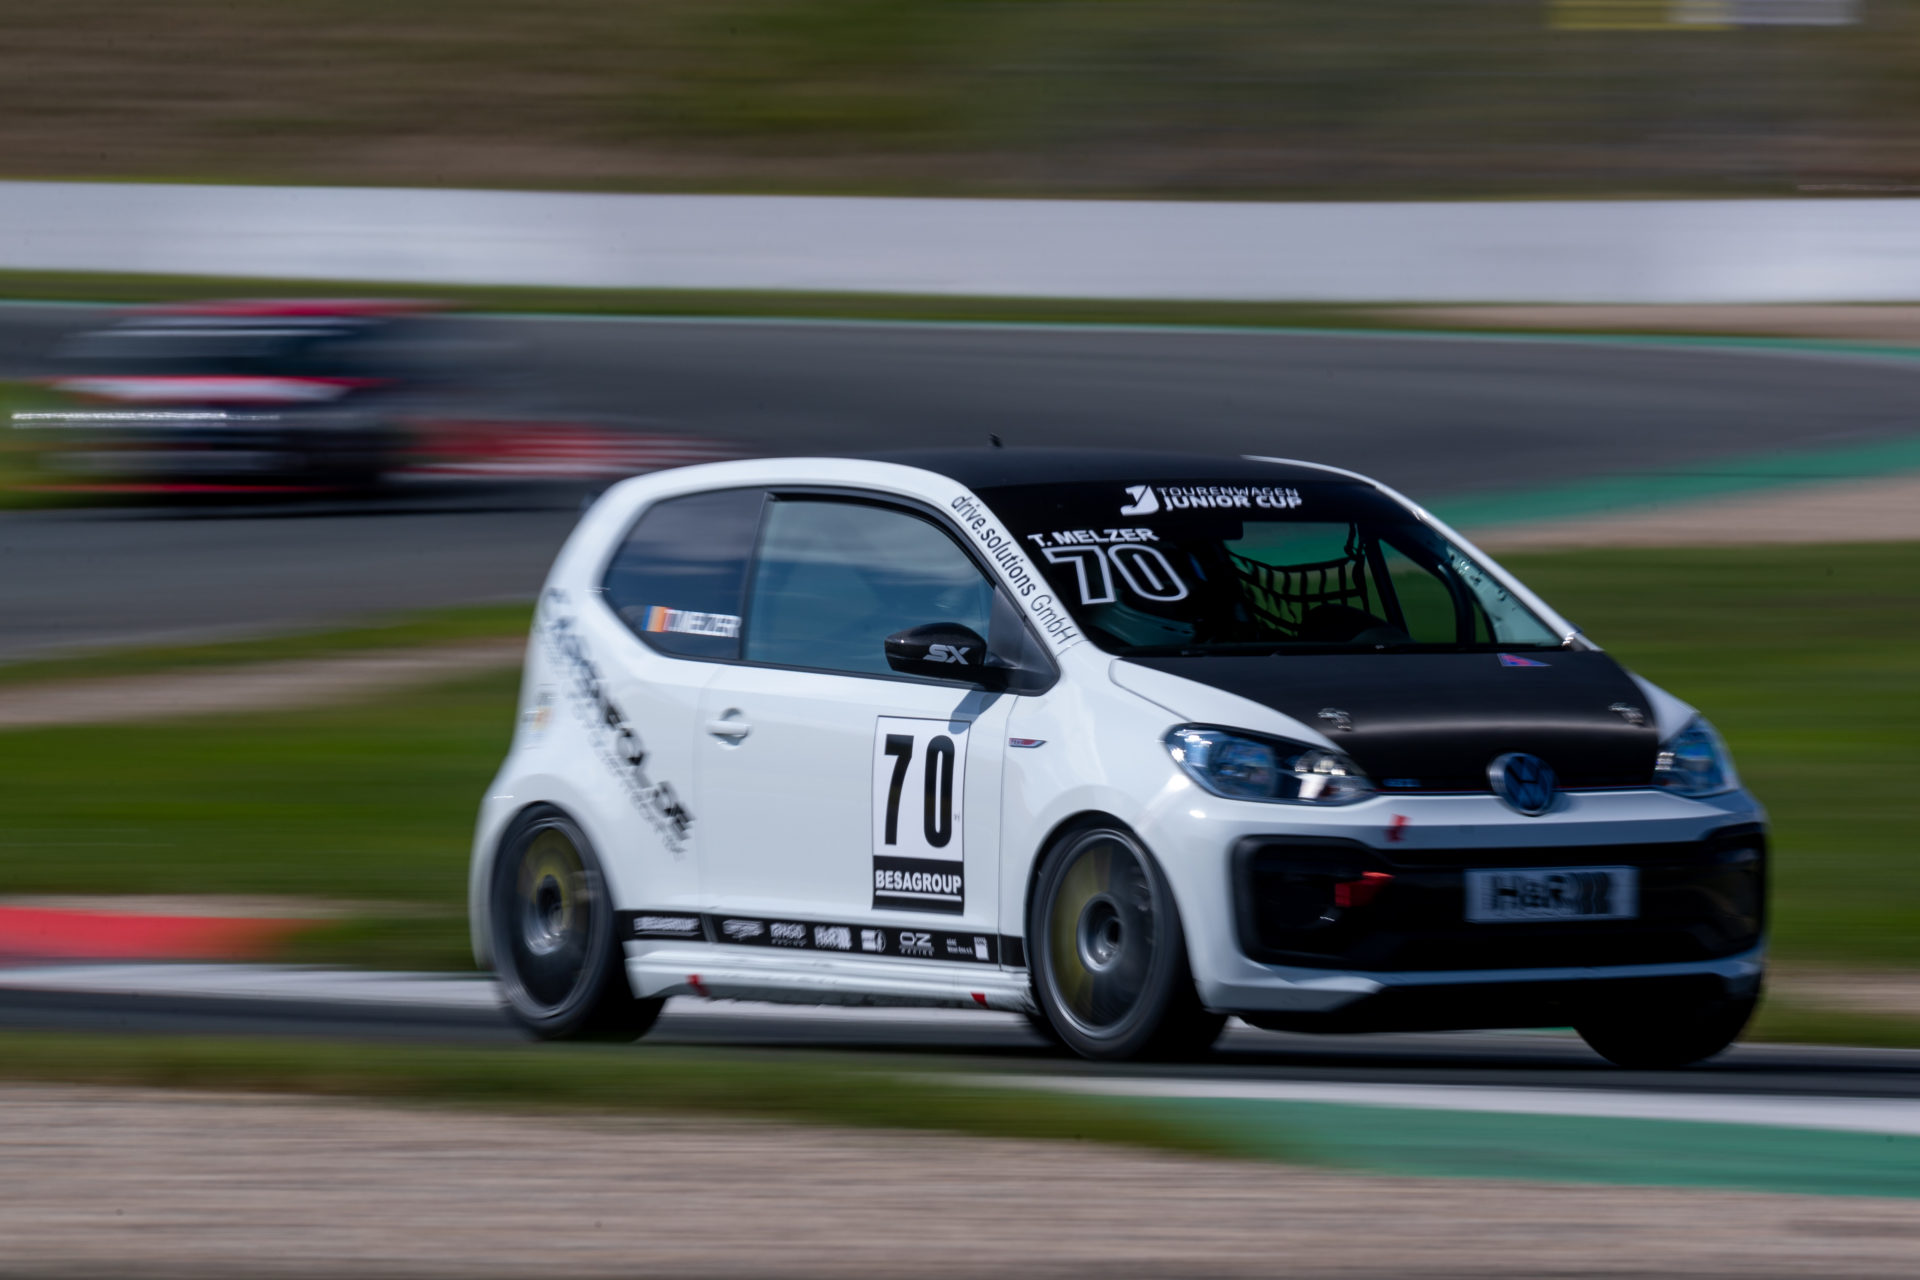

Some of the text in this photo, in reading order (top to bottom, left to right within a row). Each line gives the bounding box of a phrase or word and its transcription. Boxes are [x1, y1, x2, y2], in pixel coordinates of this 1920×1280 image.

[1157, 486, 1299, 497] TOURENWAGEN
[1165, 494, 1302, 511] JUNIOR CUP
[1027, 528, 1159, 547] T. MELZER
[951, 496, 1077, 645] drive.solutions GmbH
[1041, 544, 1188, 605] 70
[922, 644, 970, 665] SX
[884, 733, 955, 849] 70
[875, 869, 962, 894] BESAGROUP
